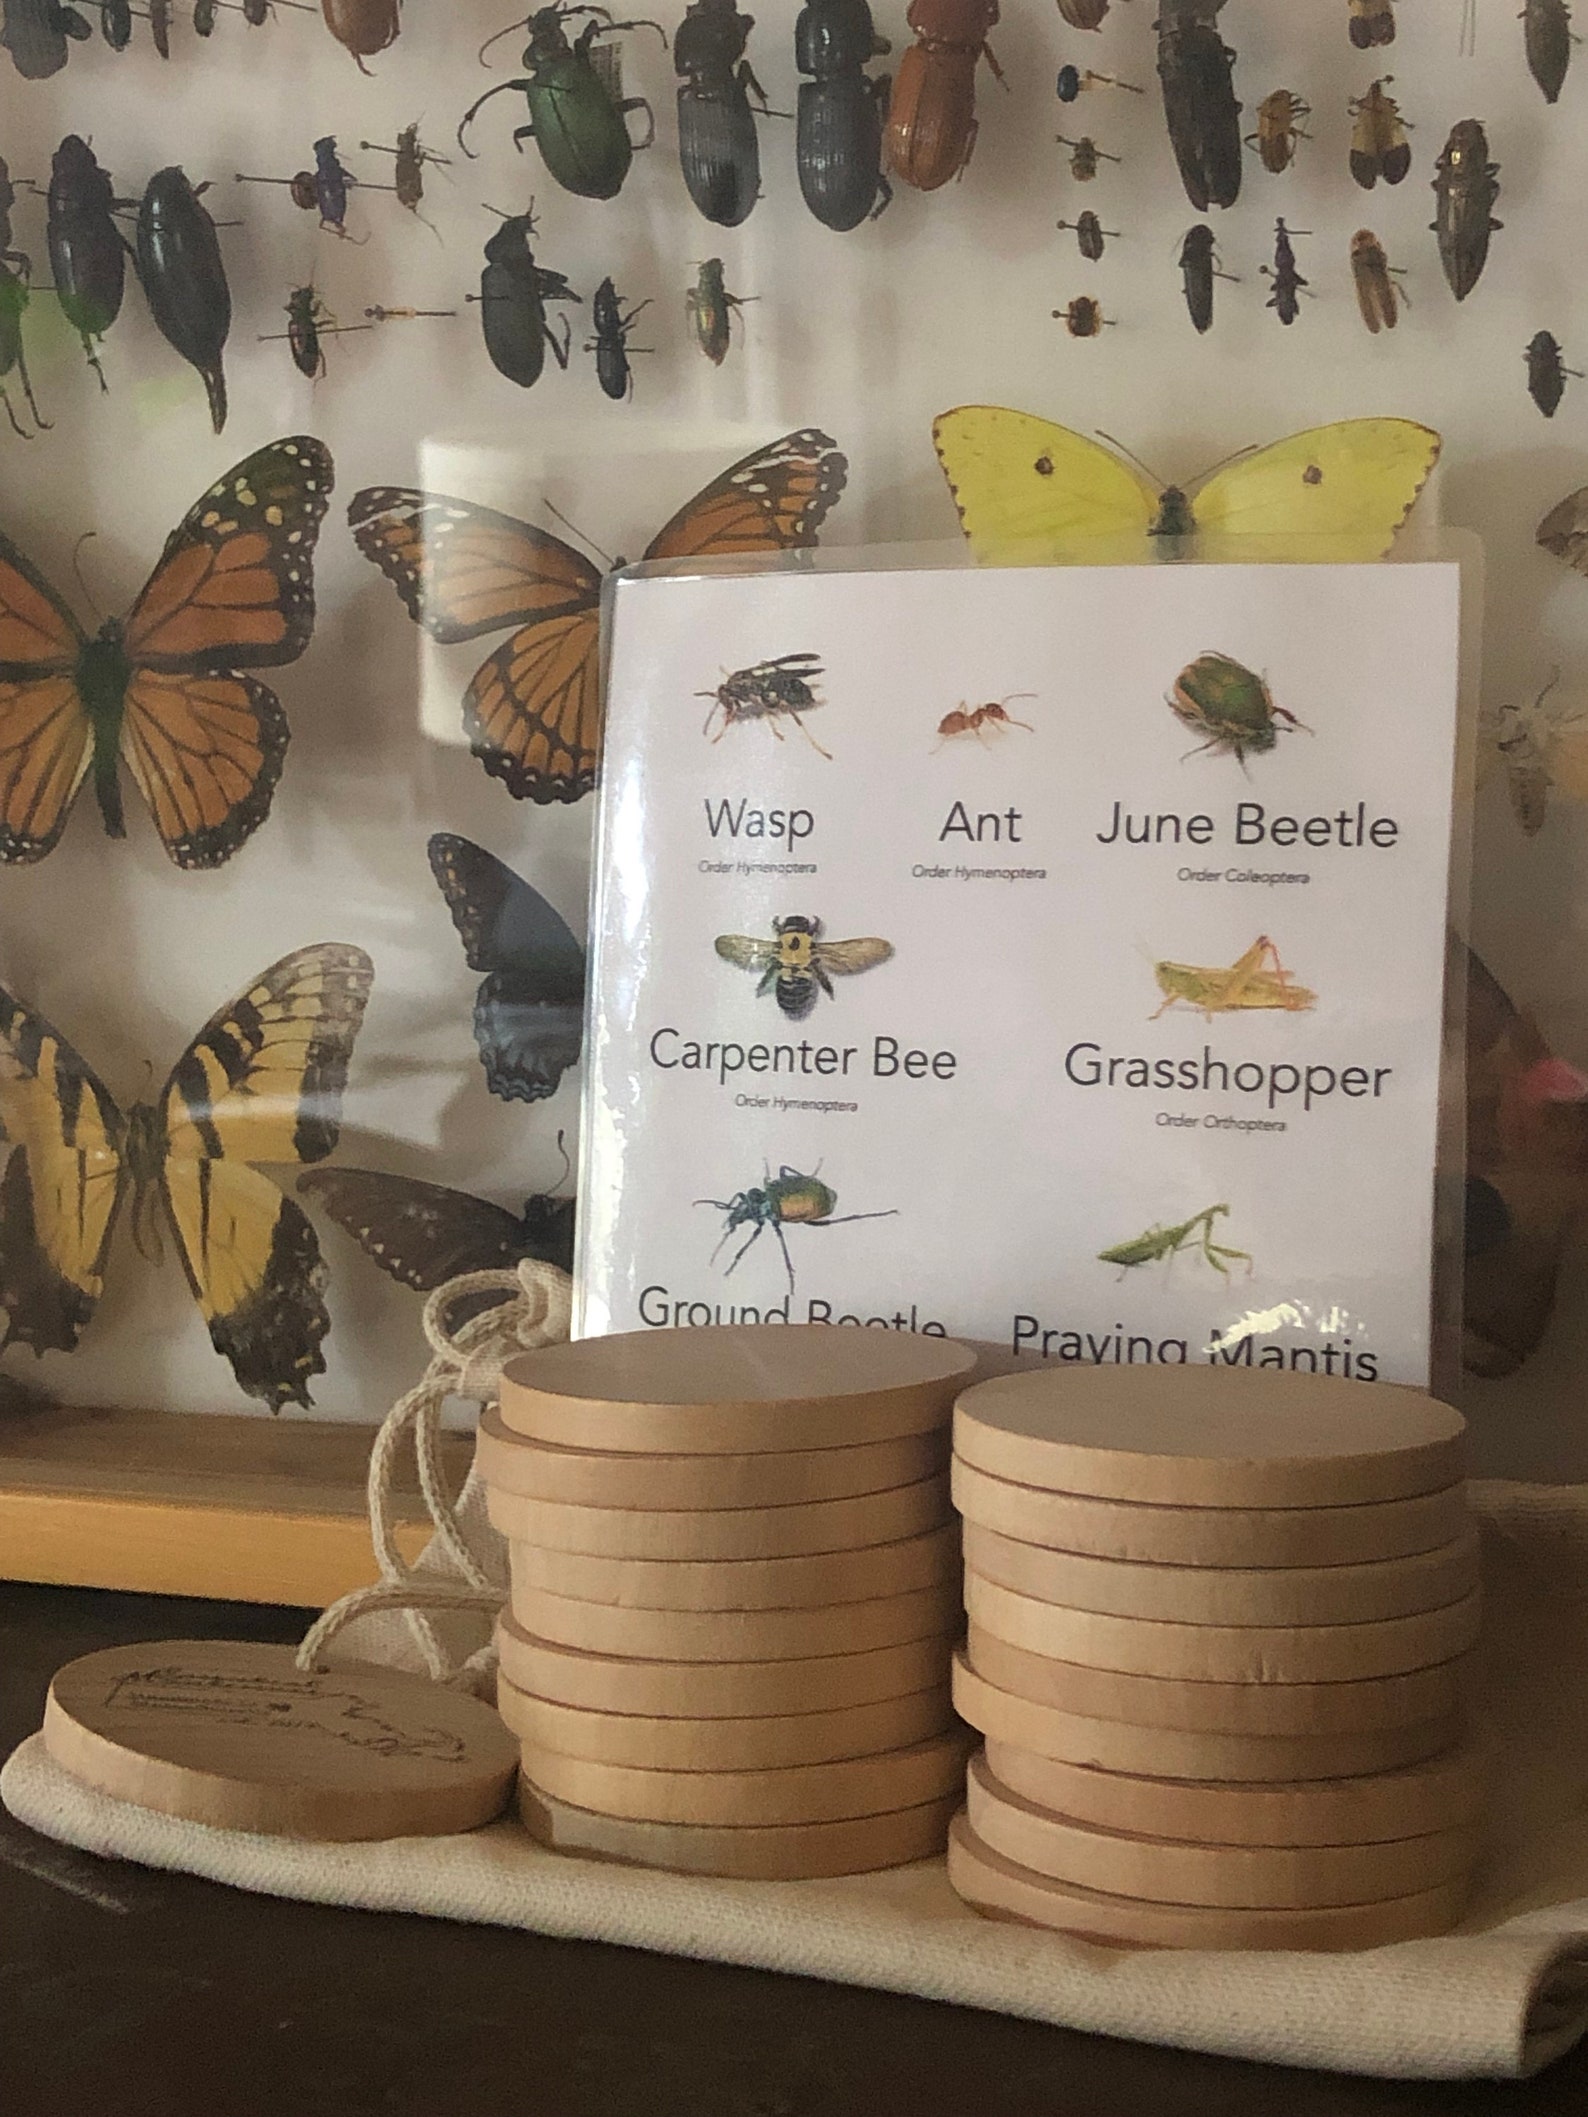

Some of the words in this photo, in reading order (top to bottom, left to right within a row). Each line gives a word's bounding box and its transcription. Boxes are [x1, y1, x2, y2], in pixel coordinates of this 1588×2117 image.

[704, 798, 814, 851] Wasp
[938, 801, 1022, 843] Ant
[1096, 801, 1213, 844] June
[1235, 802, 1399, 847] Beetle
[698, 859, 733, 873] Order
[736, 860, 818, 876] Hymenoptera
[912, 863, 951, 878] Order
[954, 864, 1047, 881] Hymenoptera
[1177, 867, 1222, 882] Order
[1225, 868, 1310, 886] Coleoptera
[650, 1028, 858, 1085] Carpenter
[873, 1036, 957, 1080] Bee
[1065, 1042, 1392, 1110] Grasshopper
[734, 1093, 770, 1109] Order
[772, 1095, 858, 1113] Hymenoptera
[1155, 1112, 1198, 1128] Order
[1203, 1113, 1286, 1132] Orthoptera
[638, 1286, 790, 1327] Ground
[1209, 1328, 1379, 1381] Mantis
